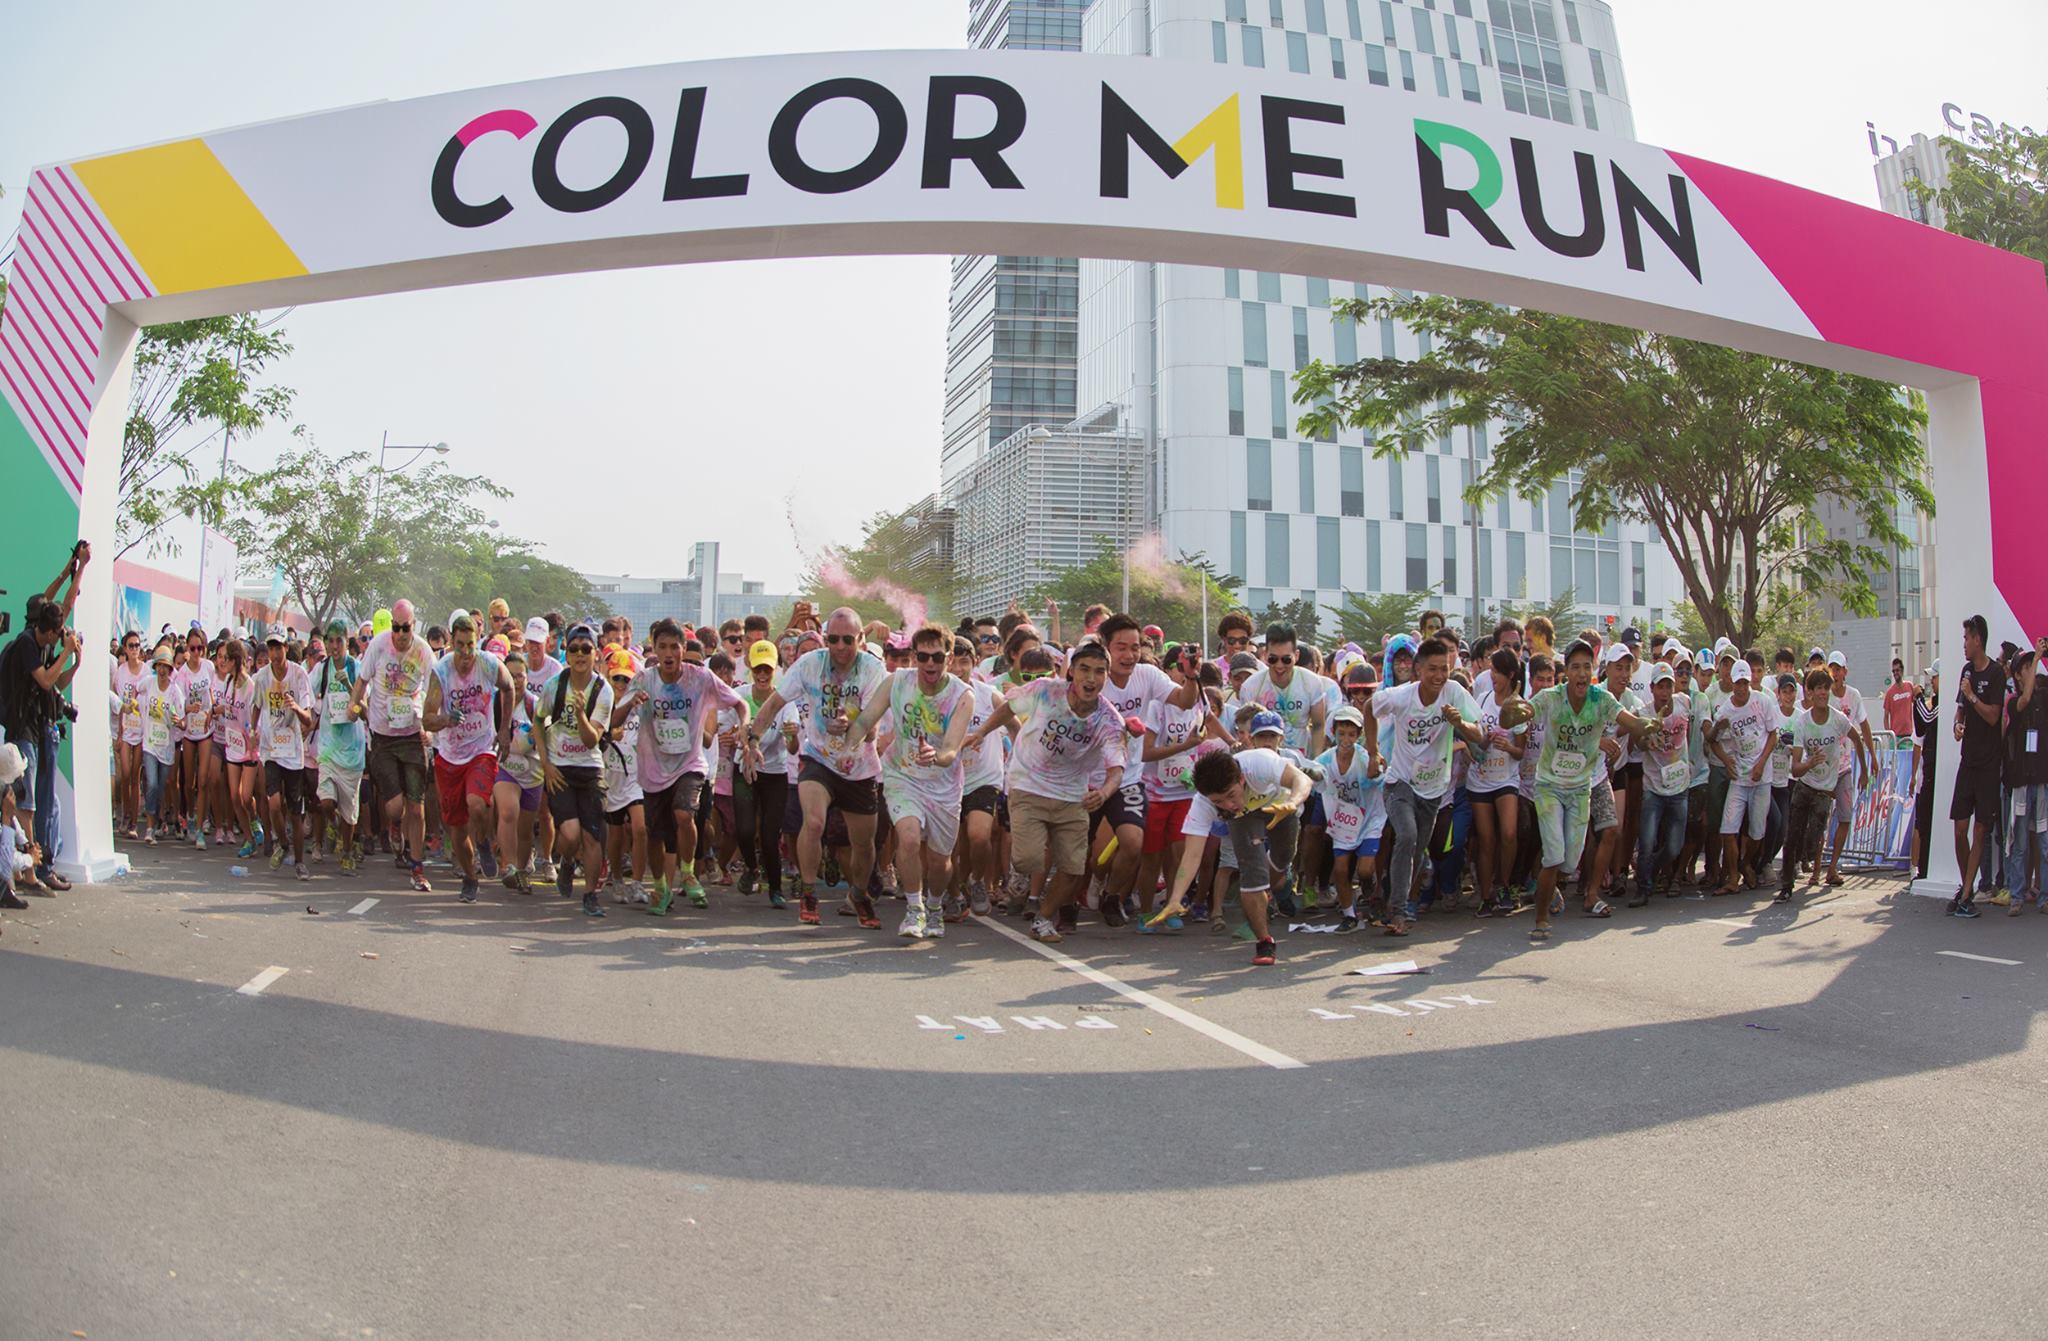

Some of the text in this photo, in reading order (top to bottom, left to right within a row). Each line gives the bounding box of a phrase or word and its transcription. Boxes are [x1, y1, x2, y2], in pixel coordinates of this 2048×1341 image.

[431, 77, 1703, 285] COLOR ME RUN
[386, 662, 416, 673] COLOR
[451, 685, 483, 700] COLOR
[822, 684, 859, 698] COLOR
[653, 698, 692, 711] COLOR
[822, 697, 840, 708] ME
[821, 708, 838, 719] RU
[1408, 714, 1447, 729] COLOR
[1732, 715, 1757, 730] COLOR
[658, 728, 685, 739] 4153
[1042, 728, 1063, 746] ME
[1048, 719, 1092, 745] COLOR
[1407, 729, 1425, 737] ME
[1559, 724, 1593, 737] COLOR
[1039, 738, 1065, 756] RUN
[1407, 736, 1432, 745] RUN
[1526, 742, 1540, 750] UN
[1556, 742, 1578, 752] RUN
[1807, 736, 1836, 747] COLOR
[1556, 760, 1582, 770] 4209
[1119, 783, 1145, 818] BOY
[1334, 811, 1359, 827] 0603
